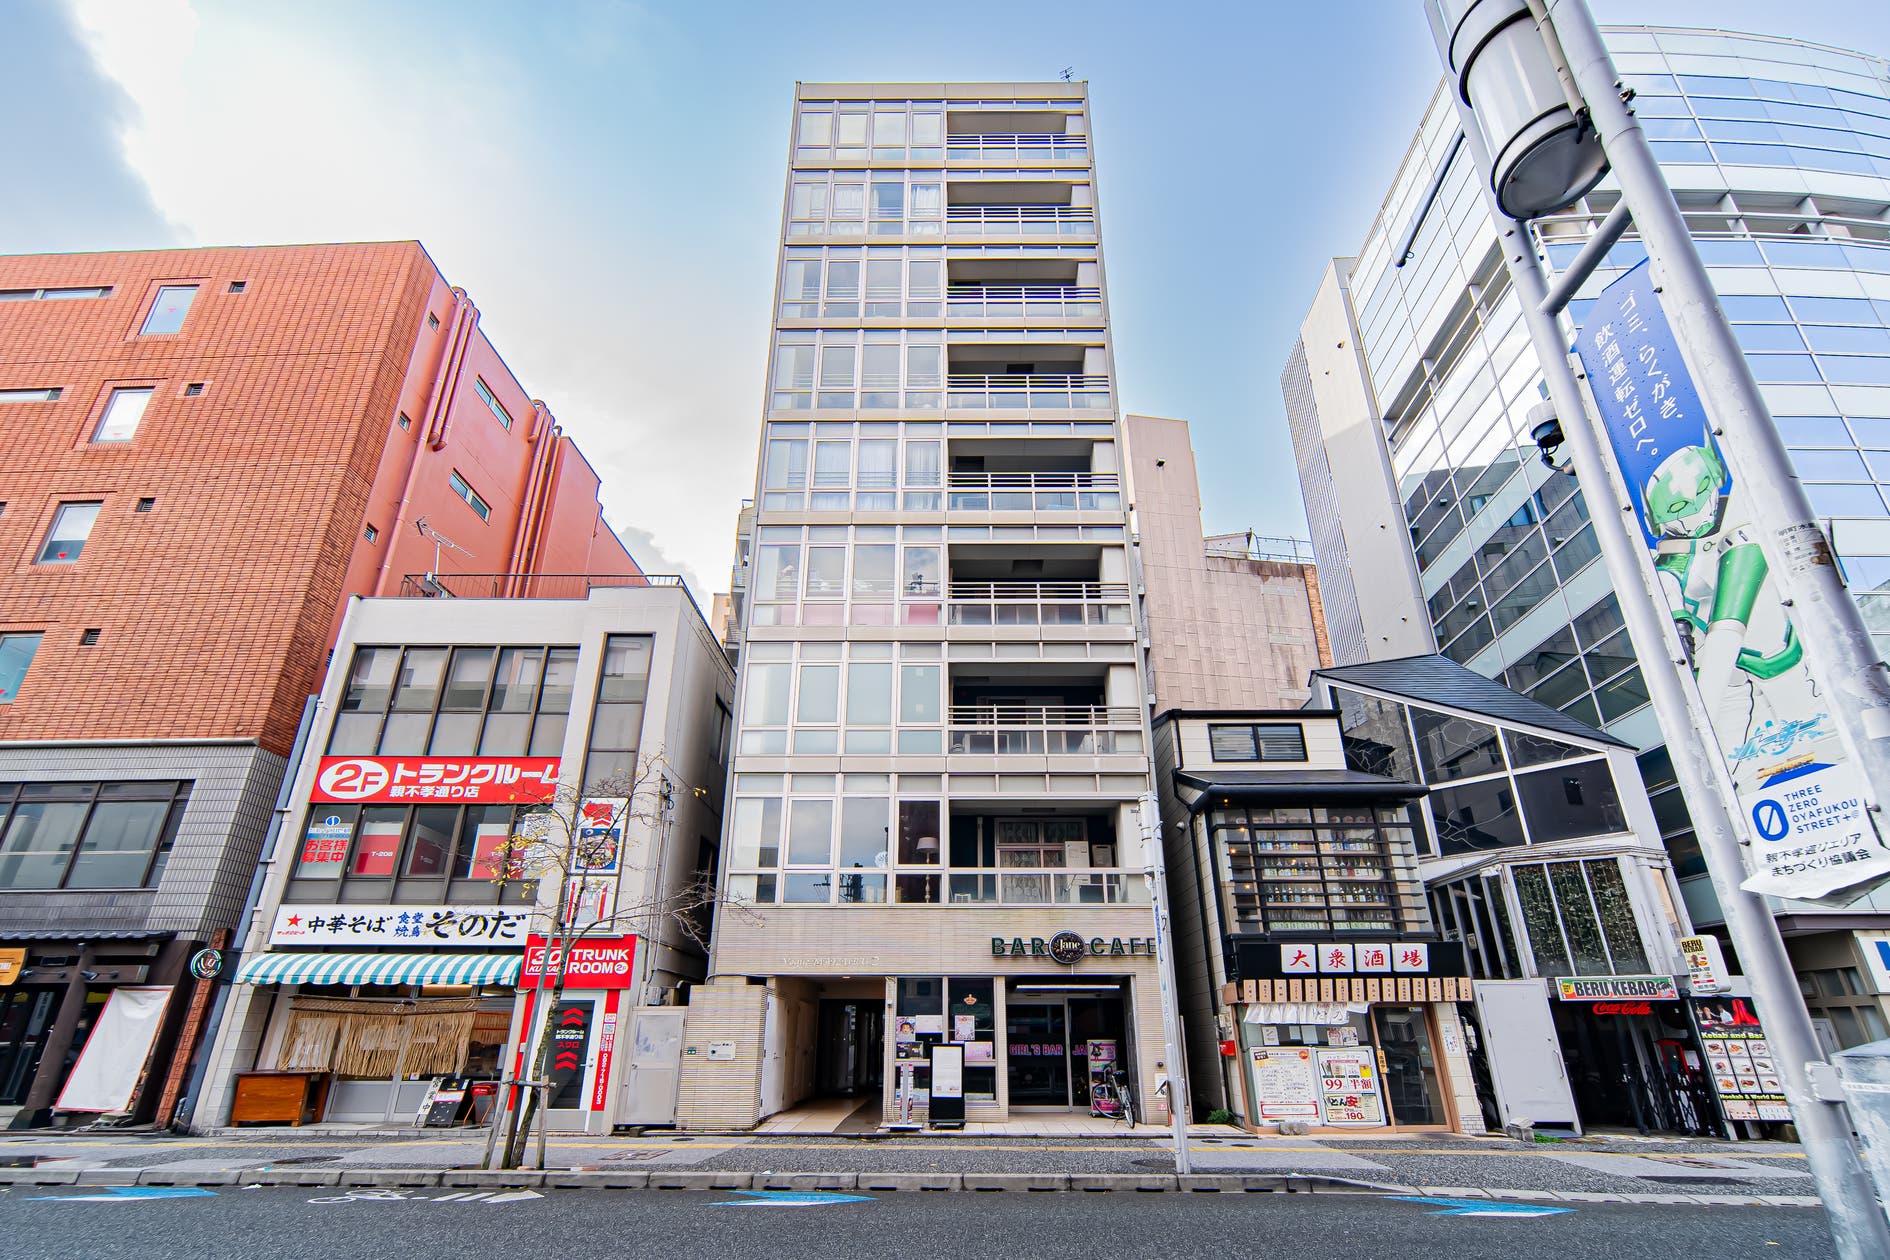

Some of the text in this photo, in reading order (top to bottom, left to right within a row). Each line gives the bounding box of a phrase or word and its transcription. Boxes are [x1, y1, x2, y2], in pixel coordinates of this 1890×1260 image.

[1594, 321, 1658, 456] 飲酒運転ゼロへ。
[330, 763, 382, 792] 2F
[389, 785, 480, 798] 親不孝通り店
[1784, 784, 1822, 801] THREE
[1788, 798, 1819, 813] ZERO
[1792, 798, 1858, 823] OYAFUKOU
[305, 839, 349, 851] お客様
[301, 851, 345, 863] 募集中
[1771, 848, 1872, 876] まちづくり協議会
[308, 914, 393, 934] 中華そば
[398, 911, 424, 925] 食堂
[425, 910, 527, 939] そのだ
[991, 937, 1156, 955] BAR Jane CAFE
[571, 949, 629, 961] TRUNK
[1290, 949, 1423, 968] 大衆酒場
[568, 962, 613, 974] ROOM
[1573, 981, 1611, 997] BERU
[1611, 981, 1659, 997] KEBAB
[1042, 1044, 1063, 1056] BAR
